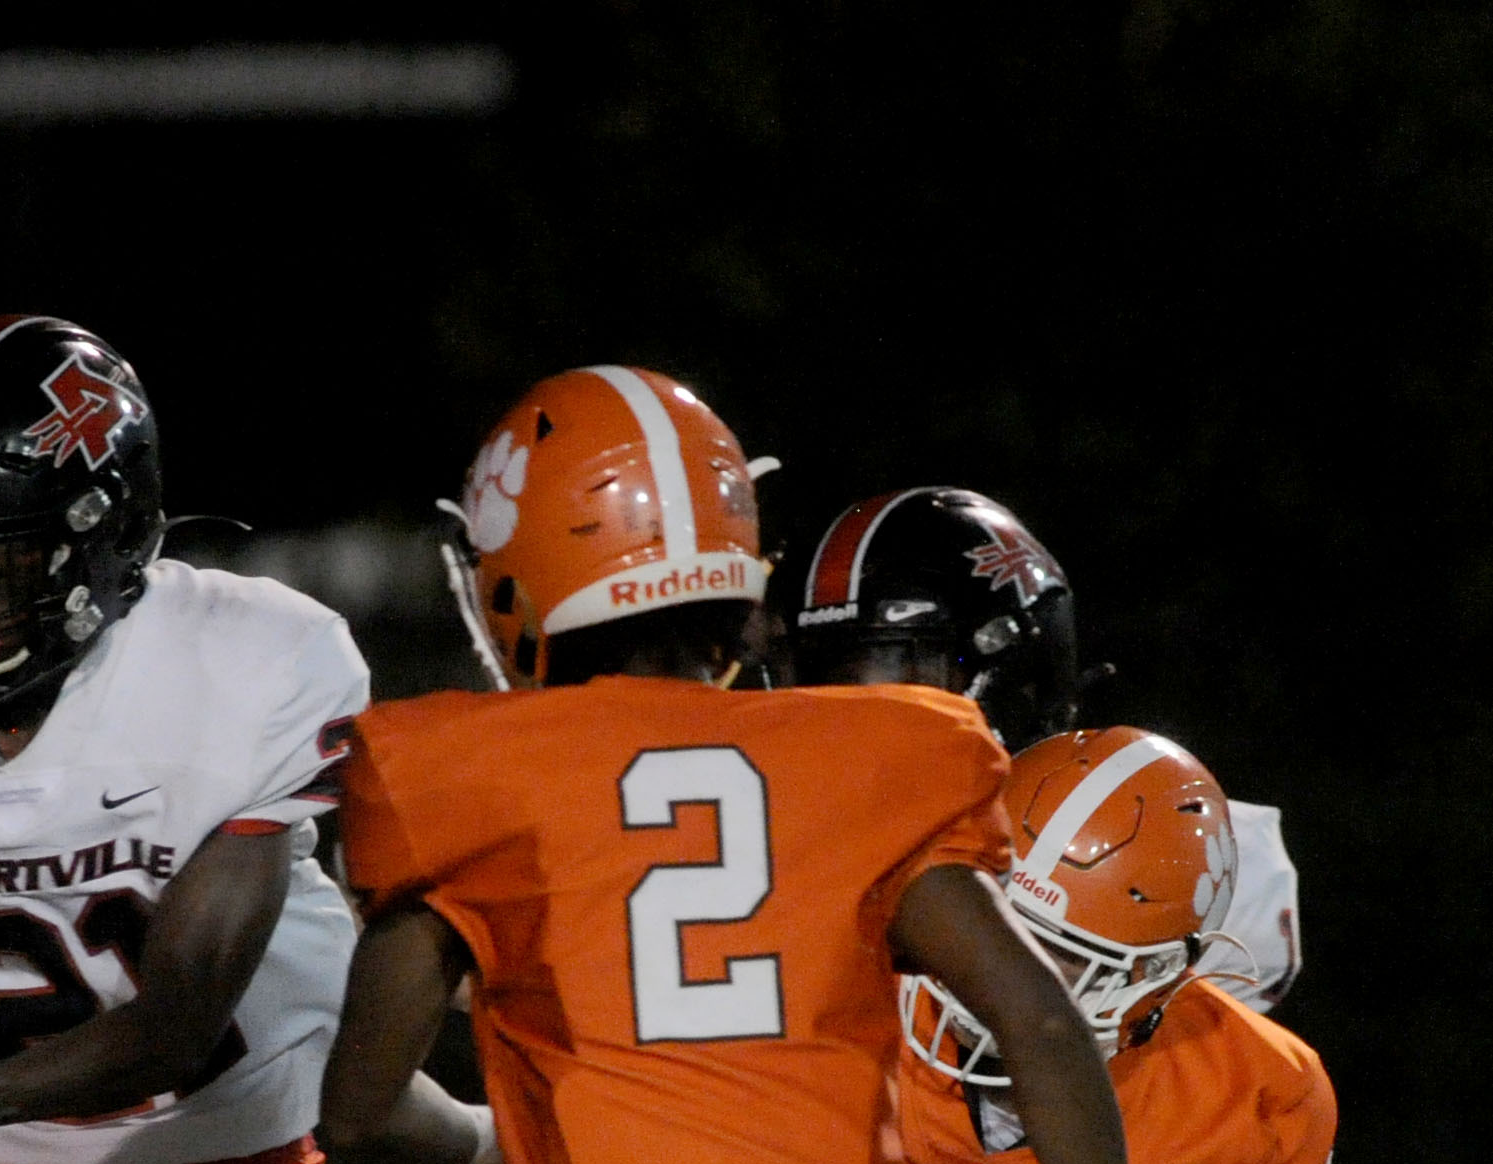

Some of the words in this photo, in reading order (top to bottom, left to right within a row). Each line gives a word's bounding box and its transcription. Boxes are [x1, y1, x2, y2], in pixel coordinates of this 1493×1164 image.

[609, 561, 746, 606] Riddell
[617, 744, 786, 1044] 2
[1011, 870, 1060, 908] ddell
